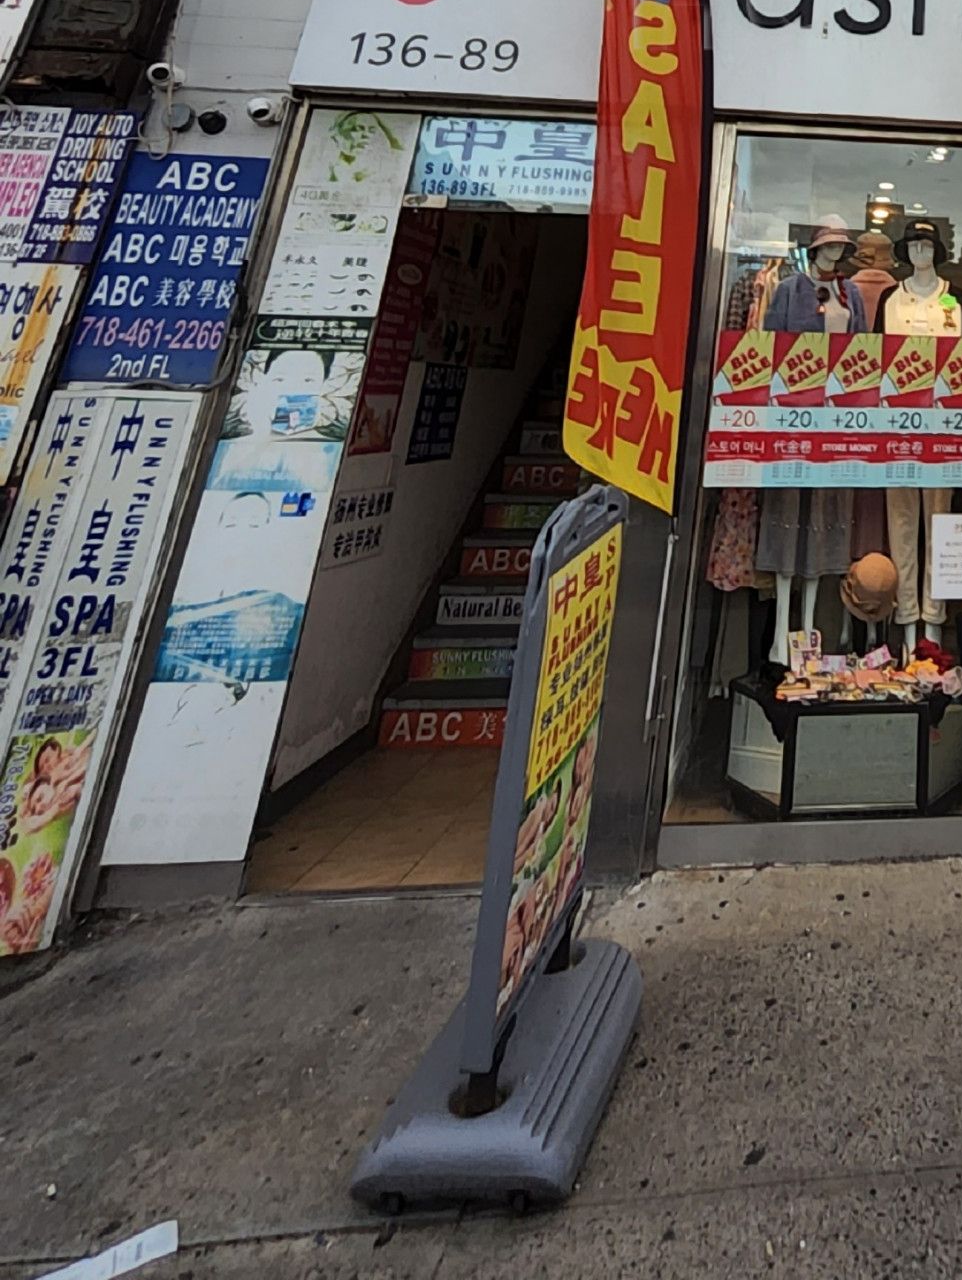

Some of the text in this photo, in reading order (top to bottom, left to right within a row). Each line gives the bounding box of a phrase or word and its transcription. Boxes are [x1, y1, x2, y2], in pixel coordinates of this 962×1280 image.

[349, 32, 520, 74] 136-89
[68, 114, 98, 134] JOY
[95, 115, 133, 136] AUTO
[59, 137, 126, 160] DRIVING
[435, 120, 594, 165] 中皇
[52, 160, 116, 183] SCHOOL
[156, 161, 240, 191] ABC
[424, 162, 593, 182] SUNNY FLUSHING
[420, 179, 467, 195] 136-89
[115, 194, 261, 229] BEAUTY ACADEMY
[102, 233, 165, 264] ABC
[88, 275, 149, 307] ABC
[74, 316, 224, 350] 718-461-2266
[105, 354, 170, 379] 2nd FL
[730, 347, 758, 369] BIG
[731, 357, 771, 385] SALE
[786, 348, 813, 371] BIG
[841, 349, 868, 371] BIG
[894, 350, 921, 372] BIG
[787, 358, 826, 387] SALE
[842, 359, 880, 387] SALE
[896, 360, 933, 388] SALE
[511, 466, 565, 487] ABC
[26, 492, 67, 587] FLUSHING
[105, 492, 151, 587] FLUSHING
[469, 548, 532, 573] ABC
[49, 593, 116, 638] SPA
[441, 598, 499, 618] Natural
[37, 646, 99, 680] 3FL
[389, 712, 462, 742] ABC
